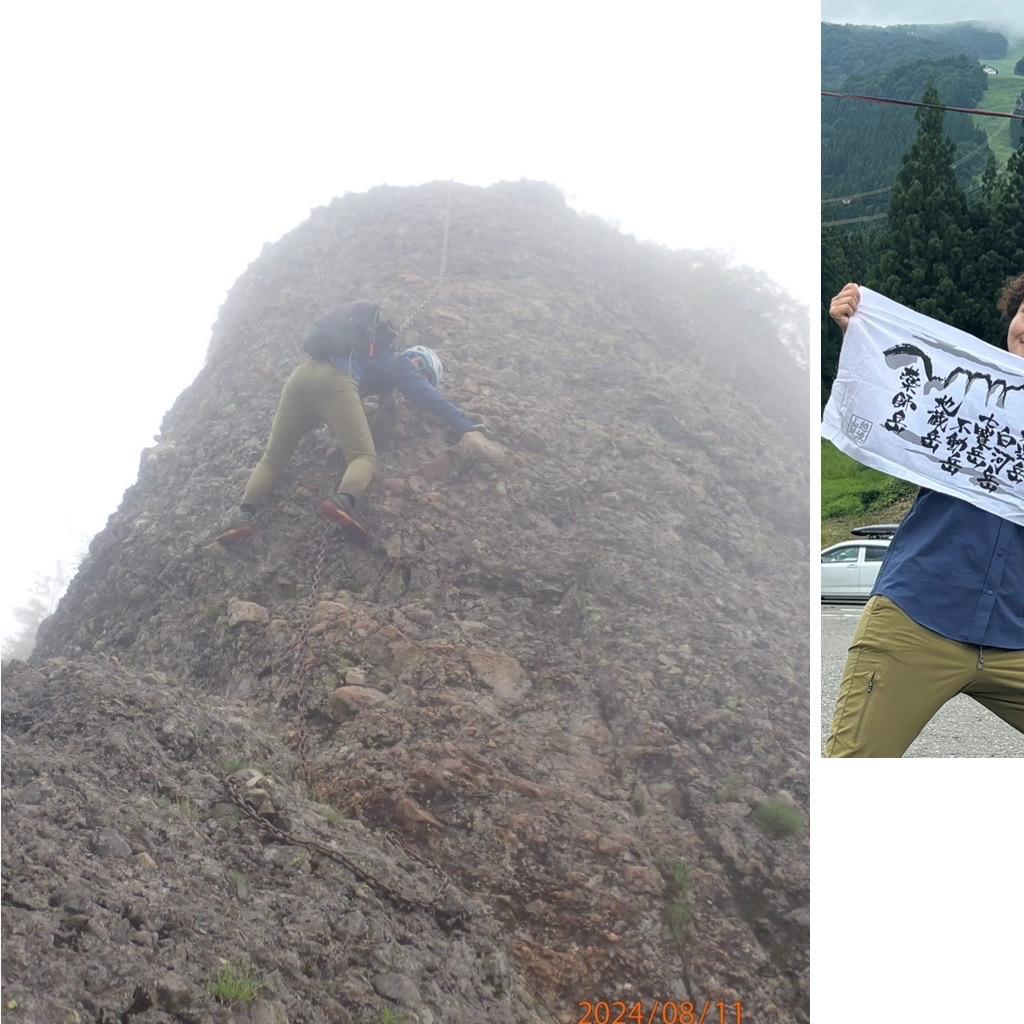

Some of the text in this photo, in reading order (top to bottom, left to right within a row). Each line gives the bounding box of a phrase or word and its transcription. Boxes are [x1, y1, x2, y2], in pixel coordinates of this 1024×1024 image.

[884, 365, 921, 433] 薬師岳
[921, 394, 963, 453] 地蔵岳
[941, 418, 971, 476] 不動岳
[977, 426, 1016, 492] 白河岳
